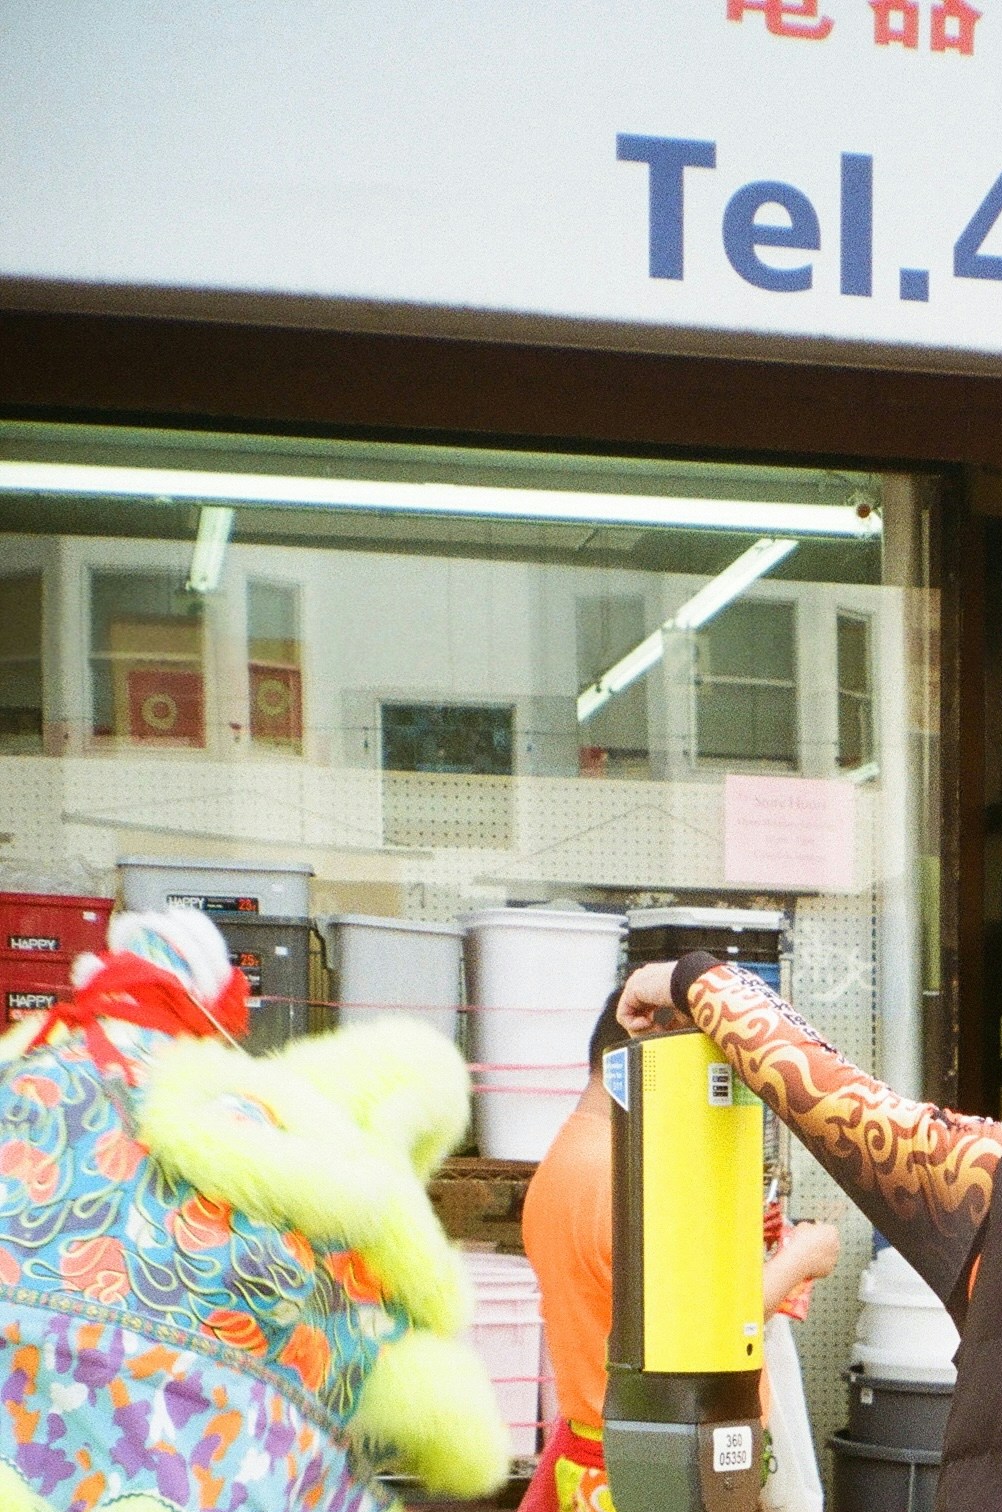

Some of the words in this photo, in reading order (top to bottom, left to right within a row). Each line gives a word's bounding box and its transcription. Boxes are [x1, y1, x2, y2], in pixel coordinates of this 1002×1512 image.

[11, 937, 55, 951] HAPPY
[9, 994, 53, 1008] HAPPY
[726, 1433, 742, 1448] 360
[719, 1450, 746, 1466] 05350
